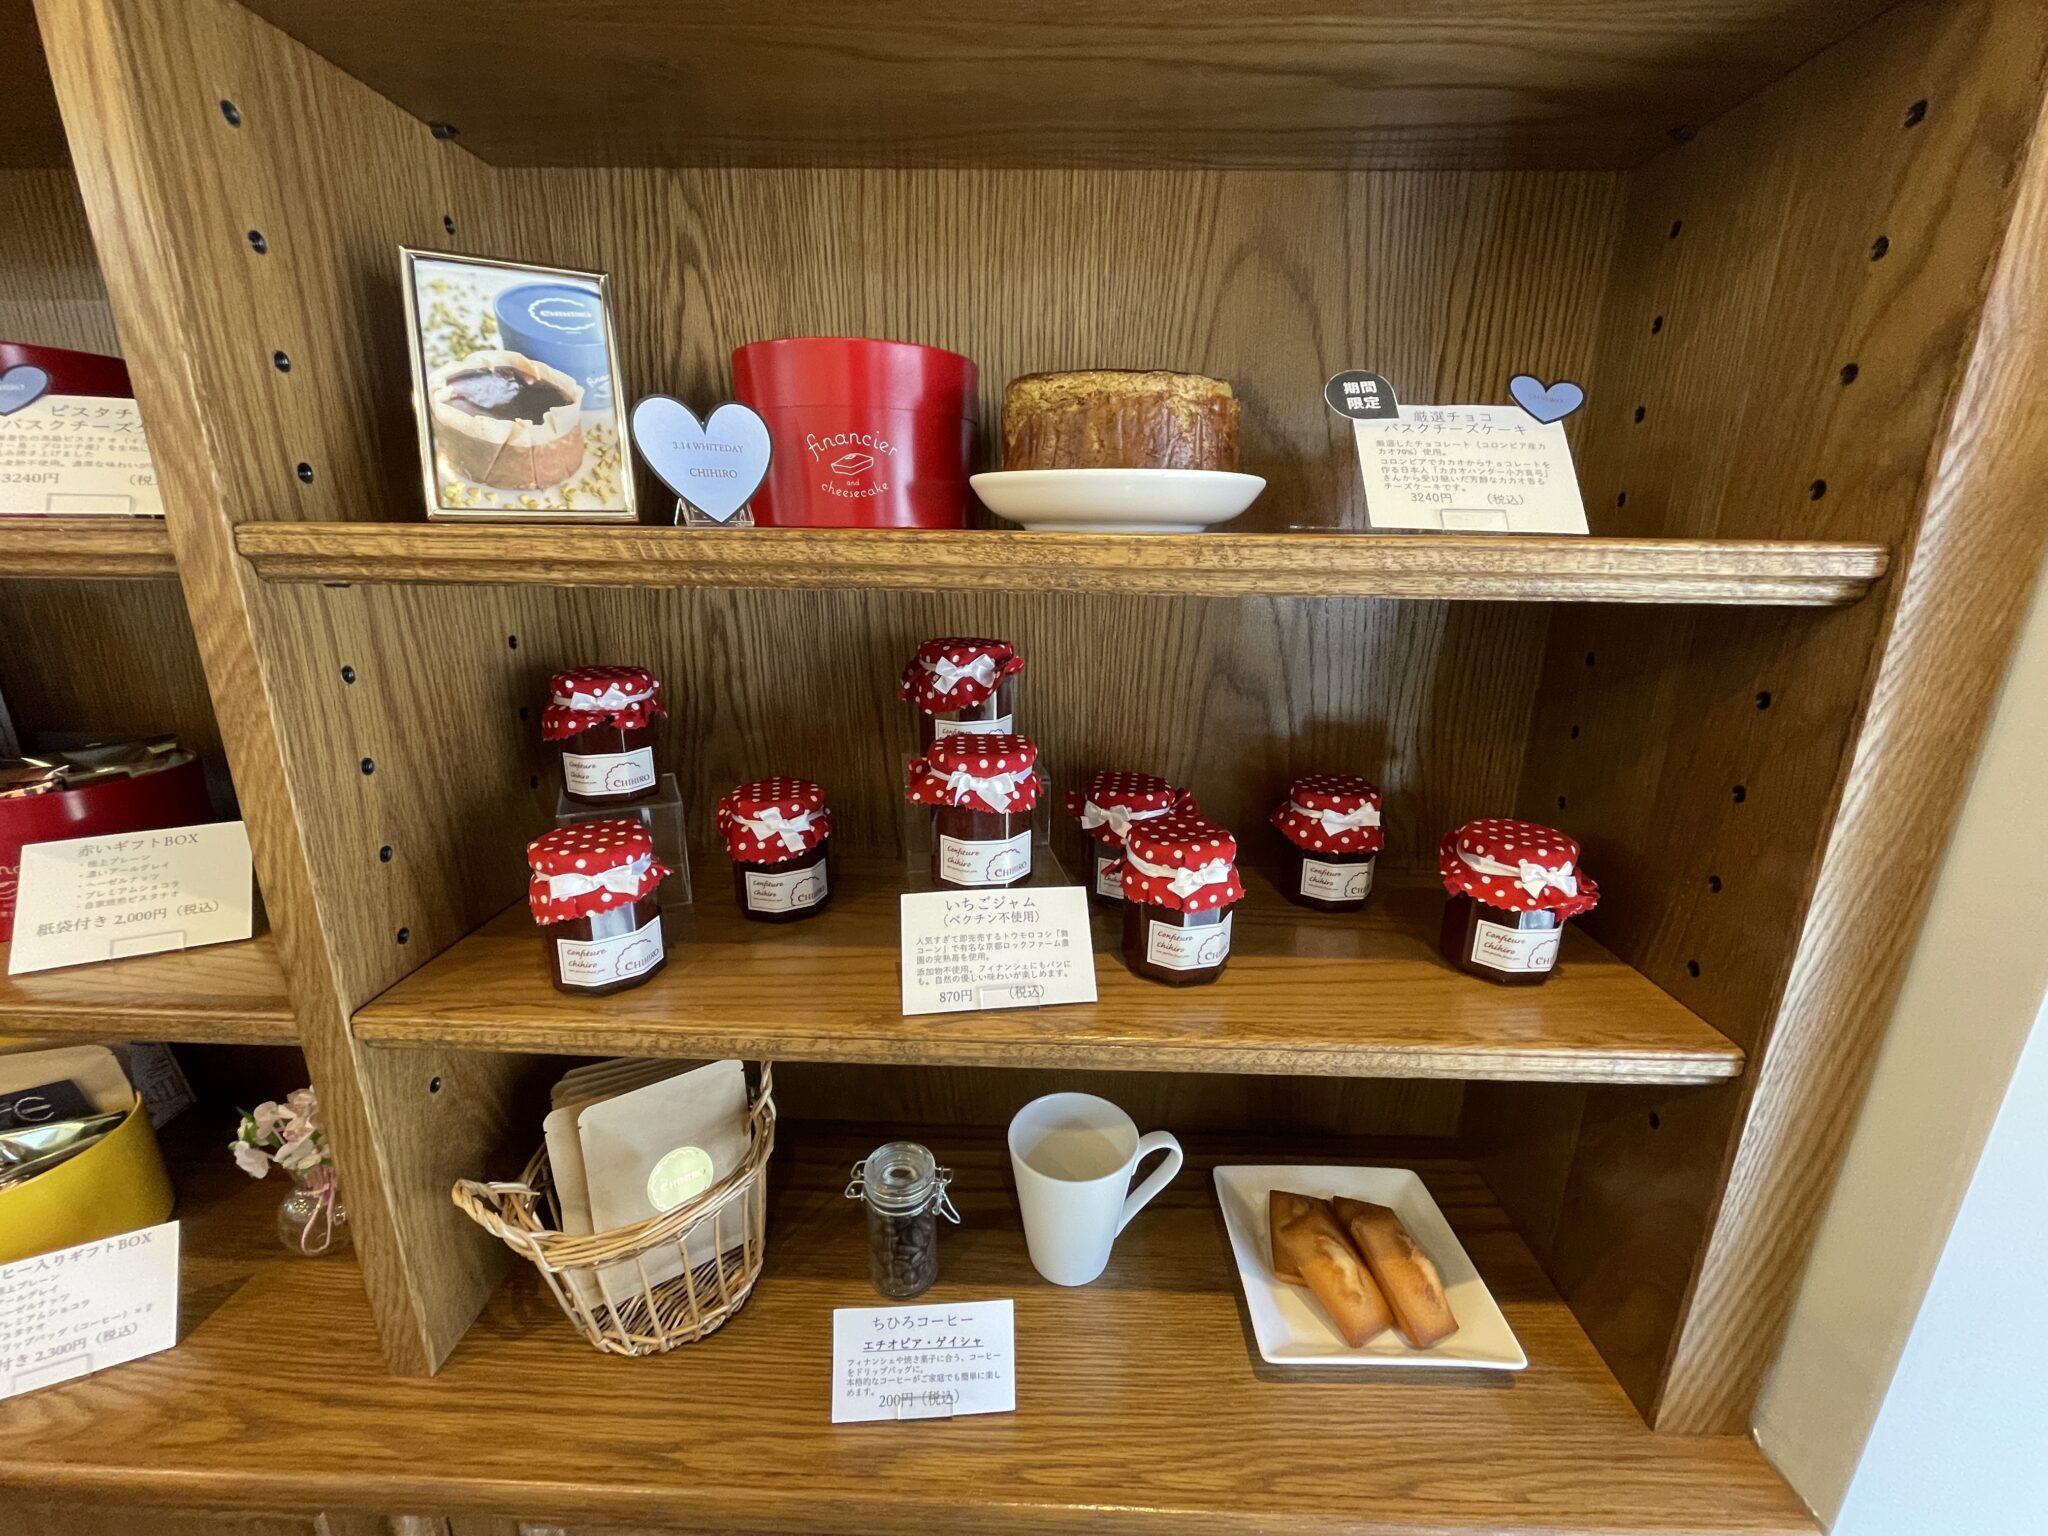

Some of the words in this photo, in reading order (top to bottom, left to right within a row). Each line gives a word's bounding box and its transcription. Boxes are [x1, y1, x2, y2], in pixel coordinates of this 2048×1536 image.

[1343, 380, 1378, 395] 期間
[1346, 396, 1382, 410] 限定
[51, 404, 140, 419] ピスタチ
[1413, 409, 1492, 424] 厳選チョコ
[1384, 422, 1528, 437] バスクチーズケーキ
[673, 441, 691, 451] 3.14
[693, 442, 744, 453] WHITEDAY
[806, 429, 899, 463] financier
[1, 472, 59, 484] 3240円
[129, 475, 158, 487] （税
[688, 467, 739, 480] CHIHIRO
[821, 480, 890, 499] cheesecake
[846, 479, 860, 487] and
[1411, 491, 1453, 503] 3240円
[613, 774, 651, 788] CHIHIRO
[77, 832, 201, 857] 赤いギフトBOX
[946, 845, 980, 857] Confiture
[945, 895, 1036, 912] いちごジャム
[36, 916, 109, 938] 紙袋付き
[1157, 930, 1194, 943] Confiture
[1485, 931, 1526, 944] Confiture
[567, 948, 607, 960] Confiture
[1483, 941, 1516, 955] Chihiro
[939, 989, 973, 1004] 870円
[872, 1313, 975, 1331] ちひろコーヒー
[862, 1335, 985, 1352] エチオピア・ゲイシャ
